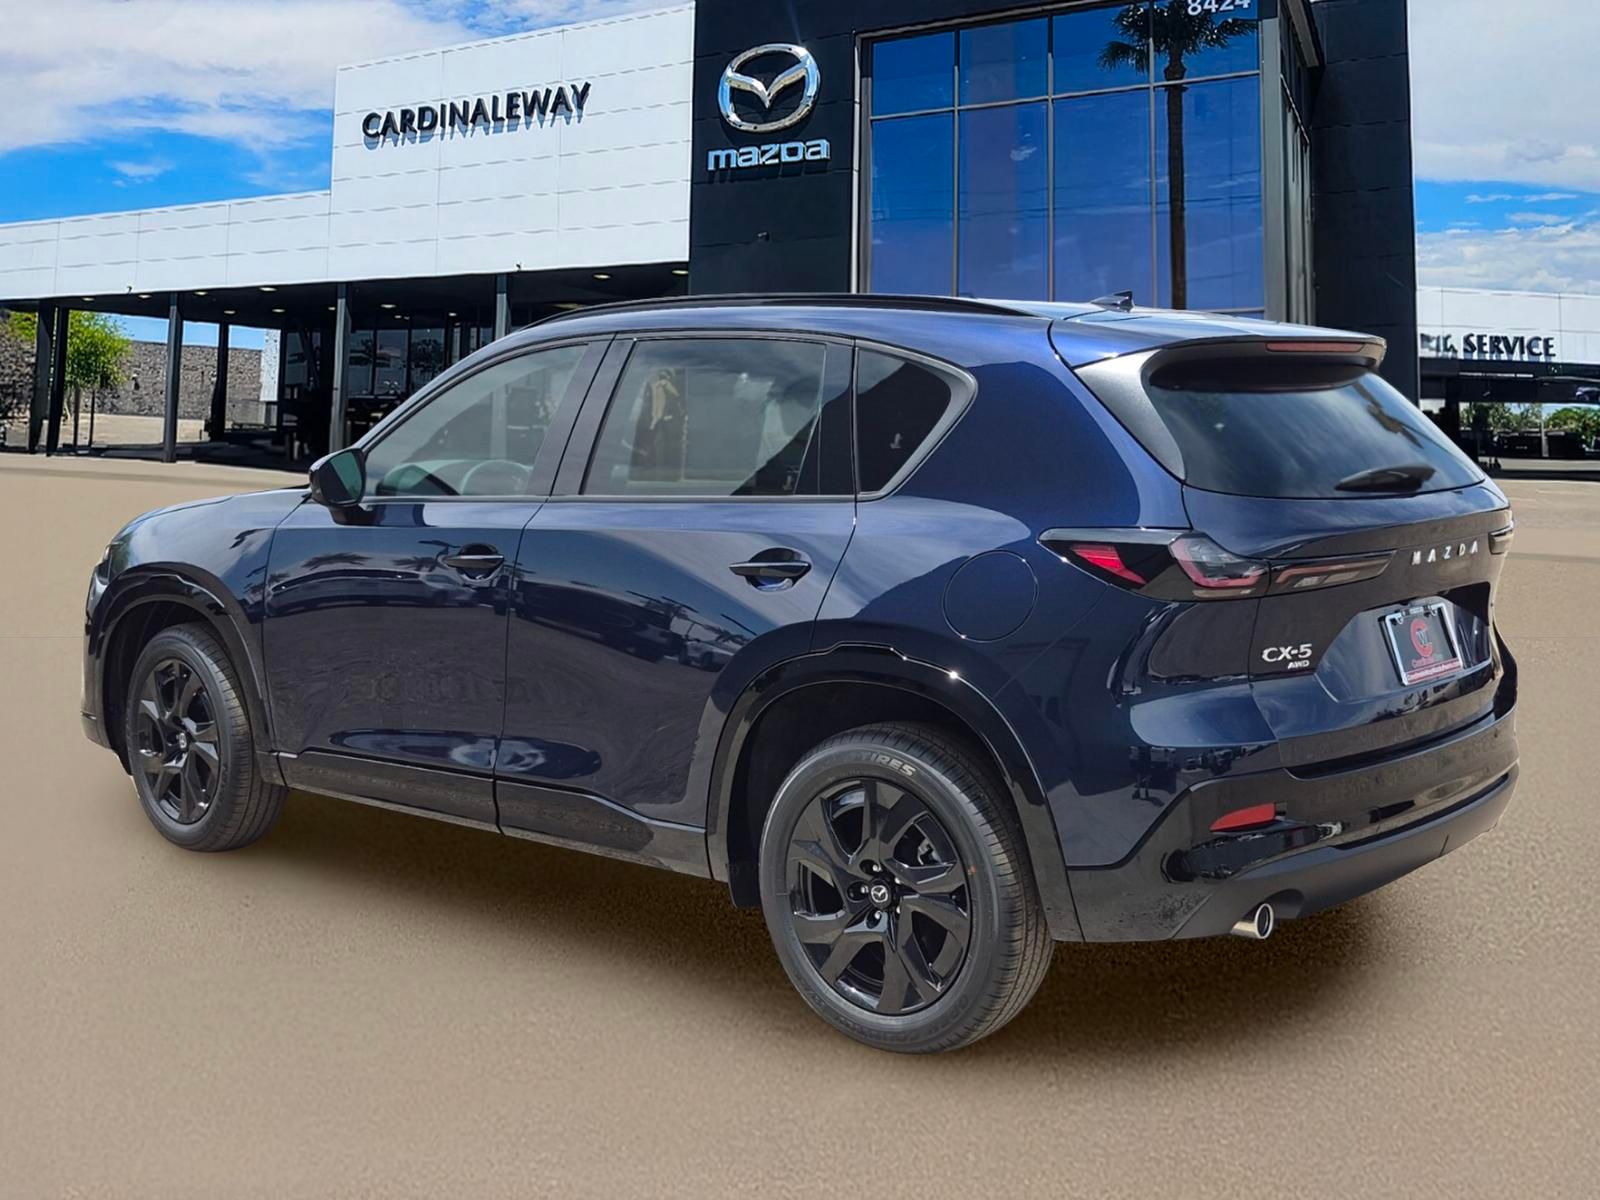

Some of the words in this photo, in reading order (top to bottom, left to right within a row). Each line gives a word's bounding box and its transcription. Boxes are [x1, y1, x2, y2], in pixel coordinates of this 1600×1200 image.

[362, 82, 591, 139] CARDINALEWAY
[707, 138, 831, 171] mazda
[1462, 333, 1557, 357] SERVICE
[1411, 540, 1479, 565] MAZDA
[1262, 643, 1313, 663] CX-5
[1287, 659, 1310, 670] AWD
